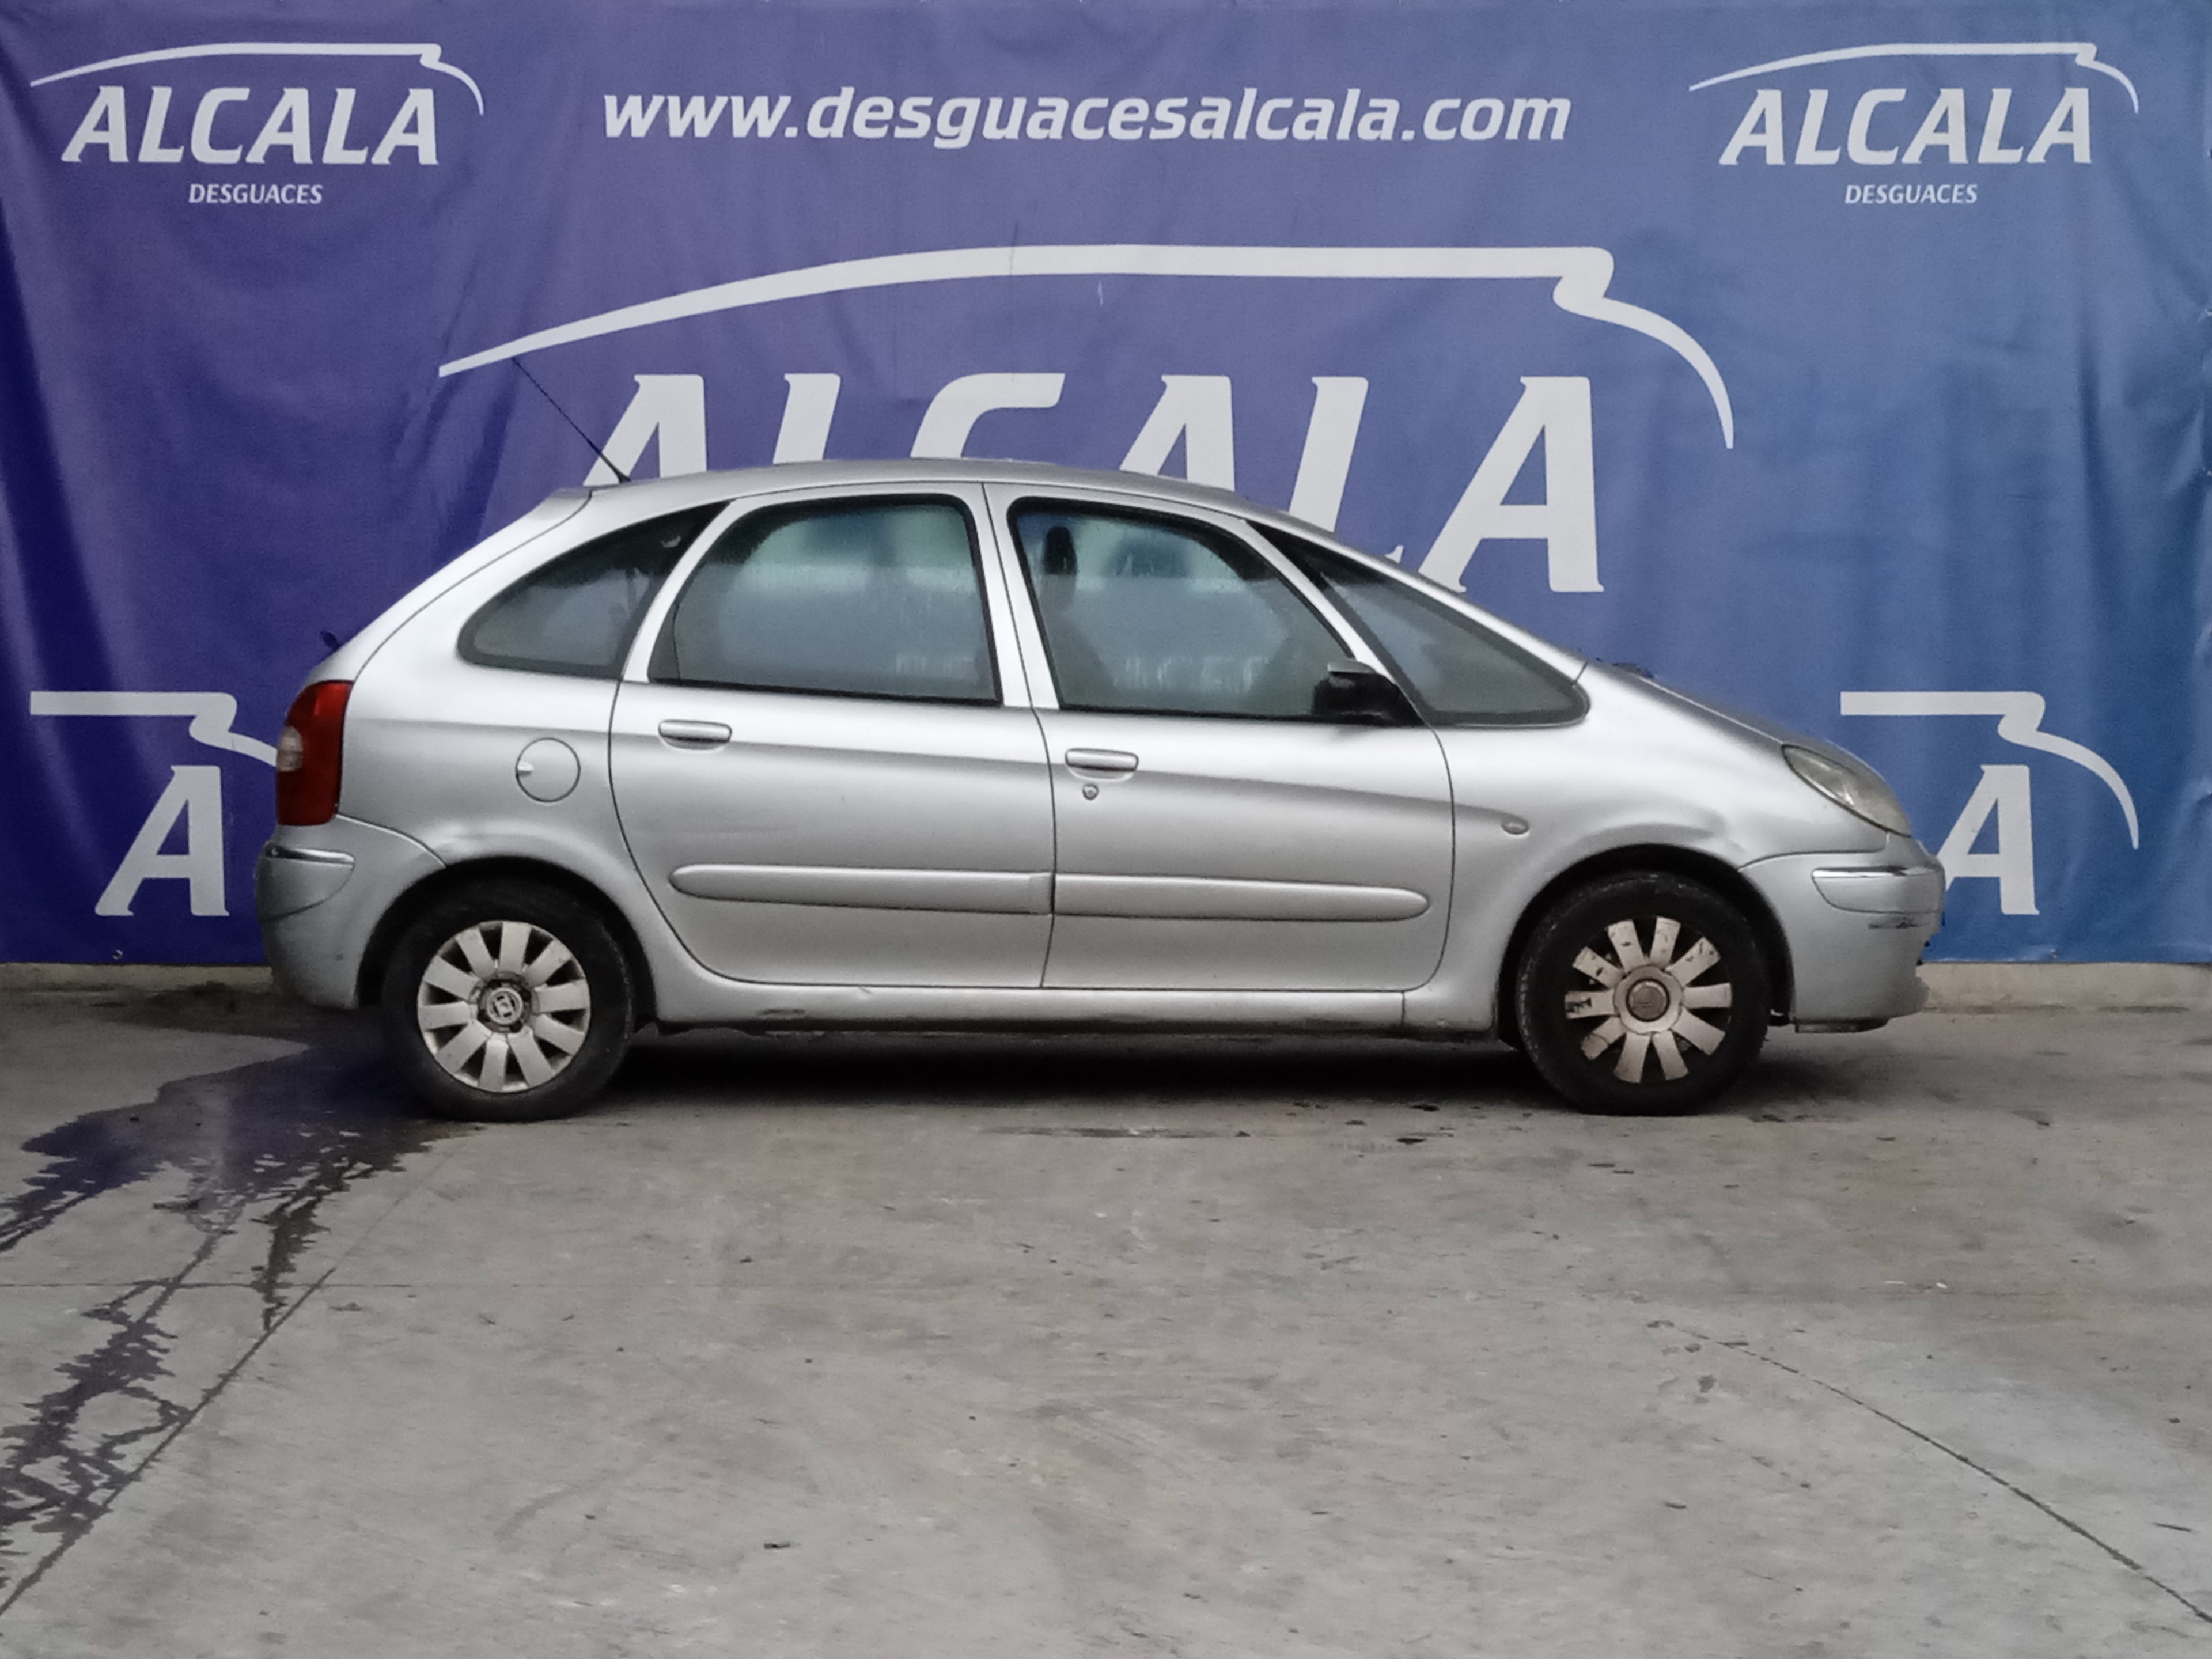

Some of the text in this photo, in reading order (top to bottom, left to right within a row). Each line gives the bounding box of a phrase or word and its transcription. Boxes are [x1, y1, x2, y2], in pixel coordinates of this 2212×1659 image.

[60, 85, 440, 166] ALCALA
[603, 86, 1572, 149] www.desguacesalcala.com
[1718, 86, 2092, 166] ALCALA
[187, 183, 324, 205] DESGUACES
[1844, 183, 1978, 205] DESGUACES
[94, 765, 230, 916] A
